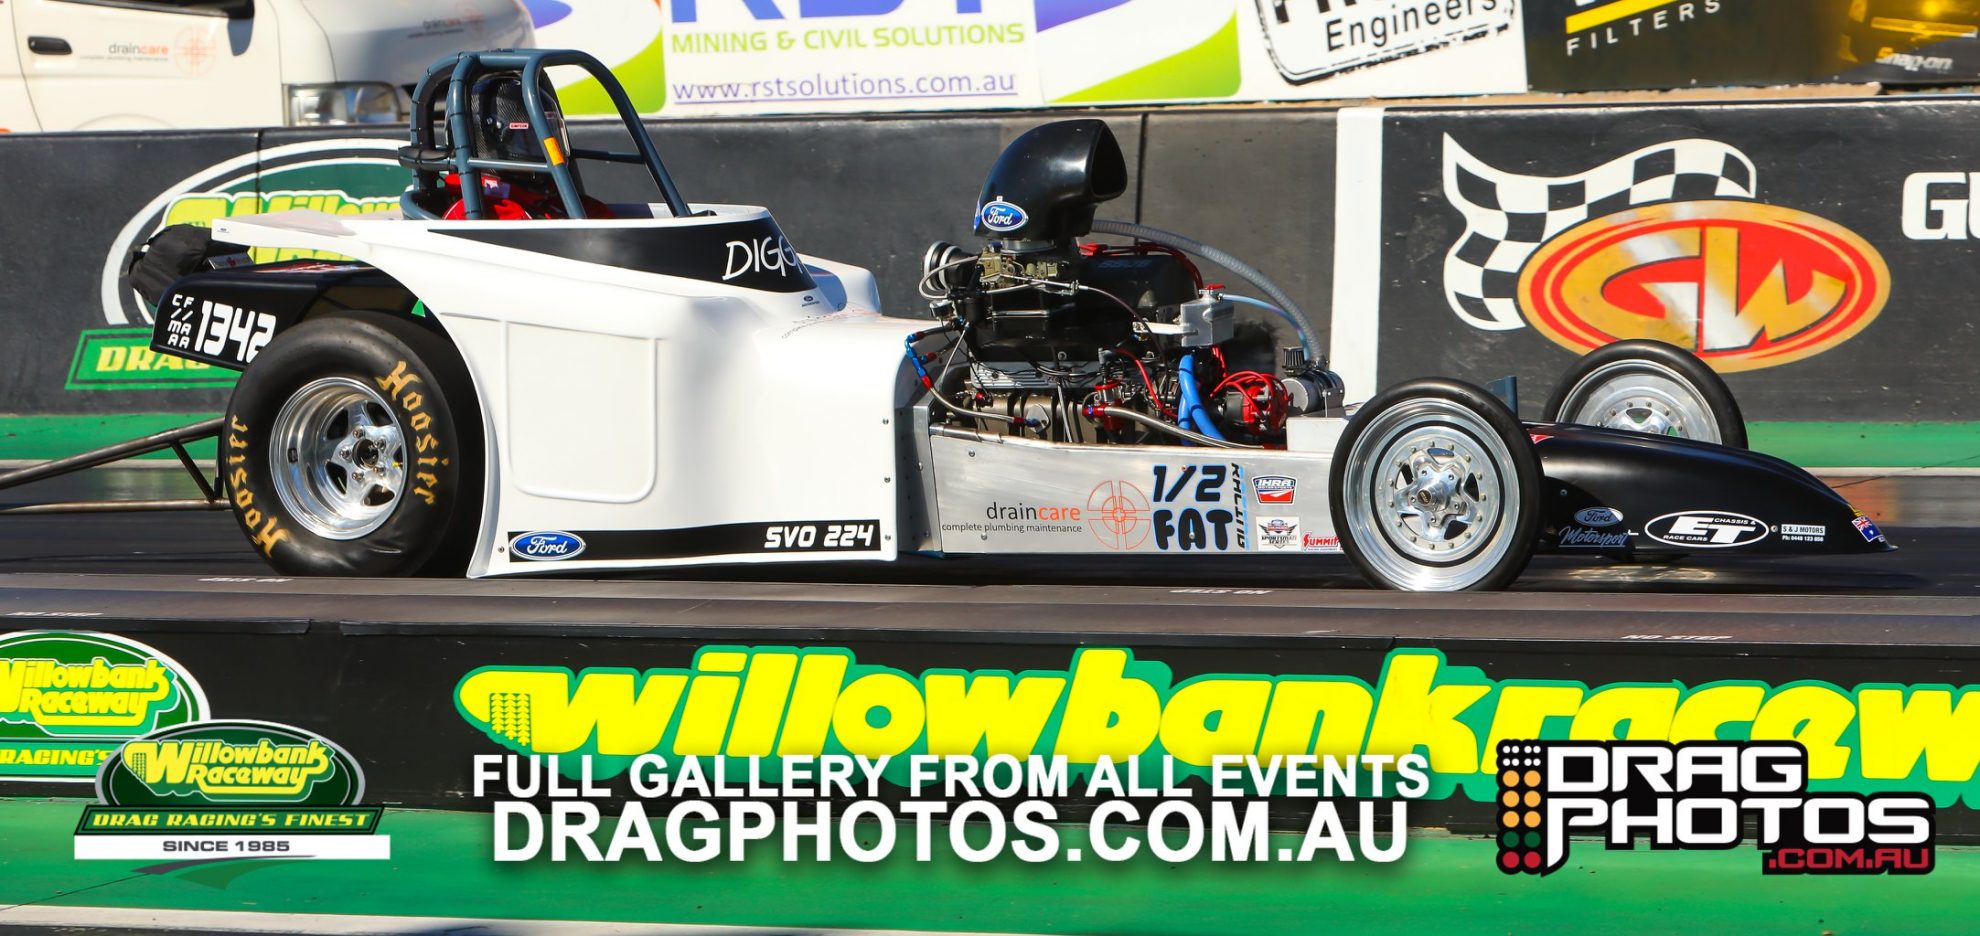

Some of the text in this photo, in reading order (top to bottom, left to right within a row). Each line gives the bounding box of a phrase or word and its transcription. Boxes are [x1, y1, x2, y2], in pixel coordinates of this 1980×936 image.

[671, 23, 1025, 54] MINING & CIVIL SOLUTIONS
[1566, 0, 1721, 56] FILTERS
[107, 42, 169, 55] draincare
[1875, 46, 1954, 72] Snap-on
[672, 72, 1018, 101] www.rstsolutions.com.au
[988, 206, 1013, 226] Ford
[194, 300, 277, 364] 1342
[376, 360, 450, 505] Hoosier
[228, 415, 289, 558] Hoosier
[1153, 464, 1228, 504] 1/2
[1258, 479, 1293, 487] IHRA
[986, 502, 1081, 521] draincare
[1585, 509, 1612, 522] Ford
[1714, 517, 1749, 525] CHASSIS
[764, 524, 874, 549] SVO 224
[941, 523, 1082, 534] complete plumbing maintenance
[1153, 508, 1233, 551] FAT
[1558, 525, 1630, 549] Motorsport
[1669, 516, 1756, 544] ET
[1686, 535, 1708, 543] CARS
[526, 536, 567, 556] Ford
